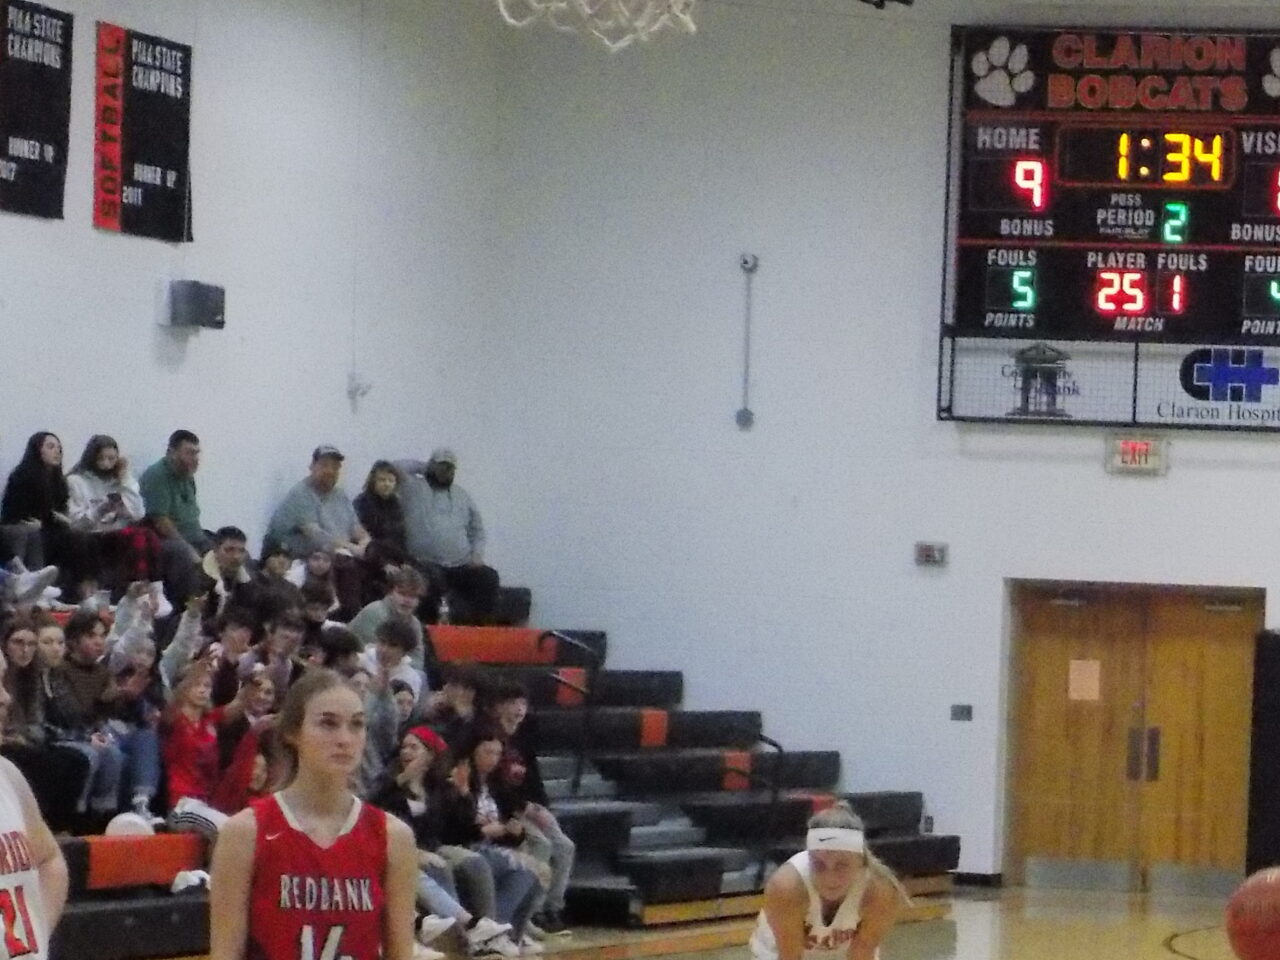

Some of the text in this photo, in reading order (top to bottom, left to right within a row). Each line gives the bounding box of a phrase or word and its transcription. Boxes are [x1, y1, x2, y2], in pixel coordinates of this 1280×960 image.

[1052, 33, 1247, 70] CLARION
[1048, 75, 1248, 110] BOBCATS
[977, 129, 1040, 149] HOME
[1118, 133, 1222, 181] 1:34
[1015, 161, 1043, 208] 9
[1110, 193, 1141, 205] POSS
[1000, 219, 1054, 235] BONUS
[1097, 208, 1155, 226] PERIOD
[1164, 203, 1188, 242] 2
[987, 250, 1037, 266] FOULS
[1087, 253, 1207, 270] PLAYER FOULS
[1012, 271, 1032, 308] 5
[1098, 272, 1145, 310] 25
[1173, 275, 1181, 309] 1
[984, 313, 1035, 328] POINTS
[1114, 317, 1163, 332] MATCH
[1156, 401, 1221, 420] Clarion
[279, 874, 373, 912] REDBANK
